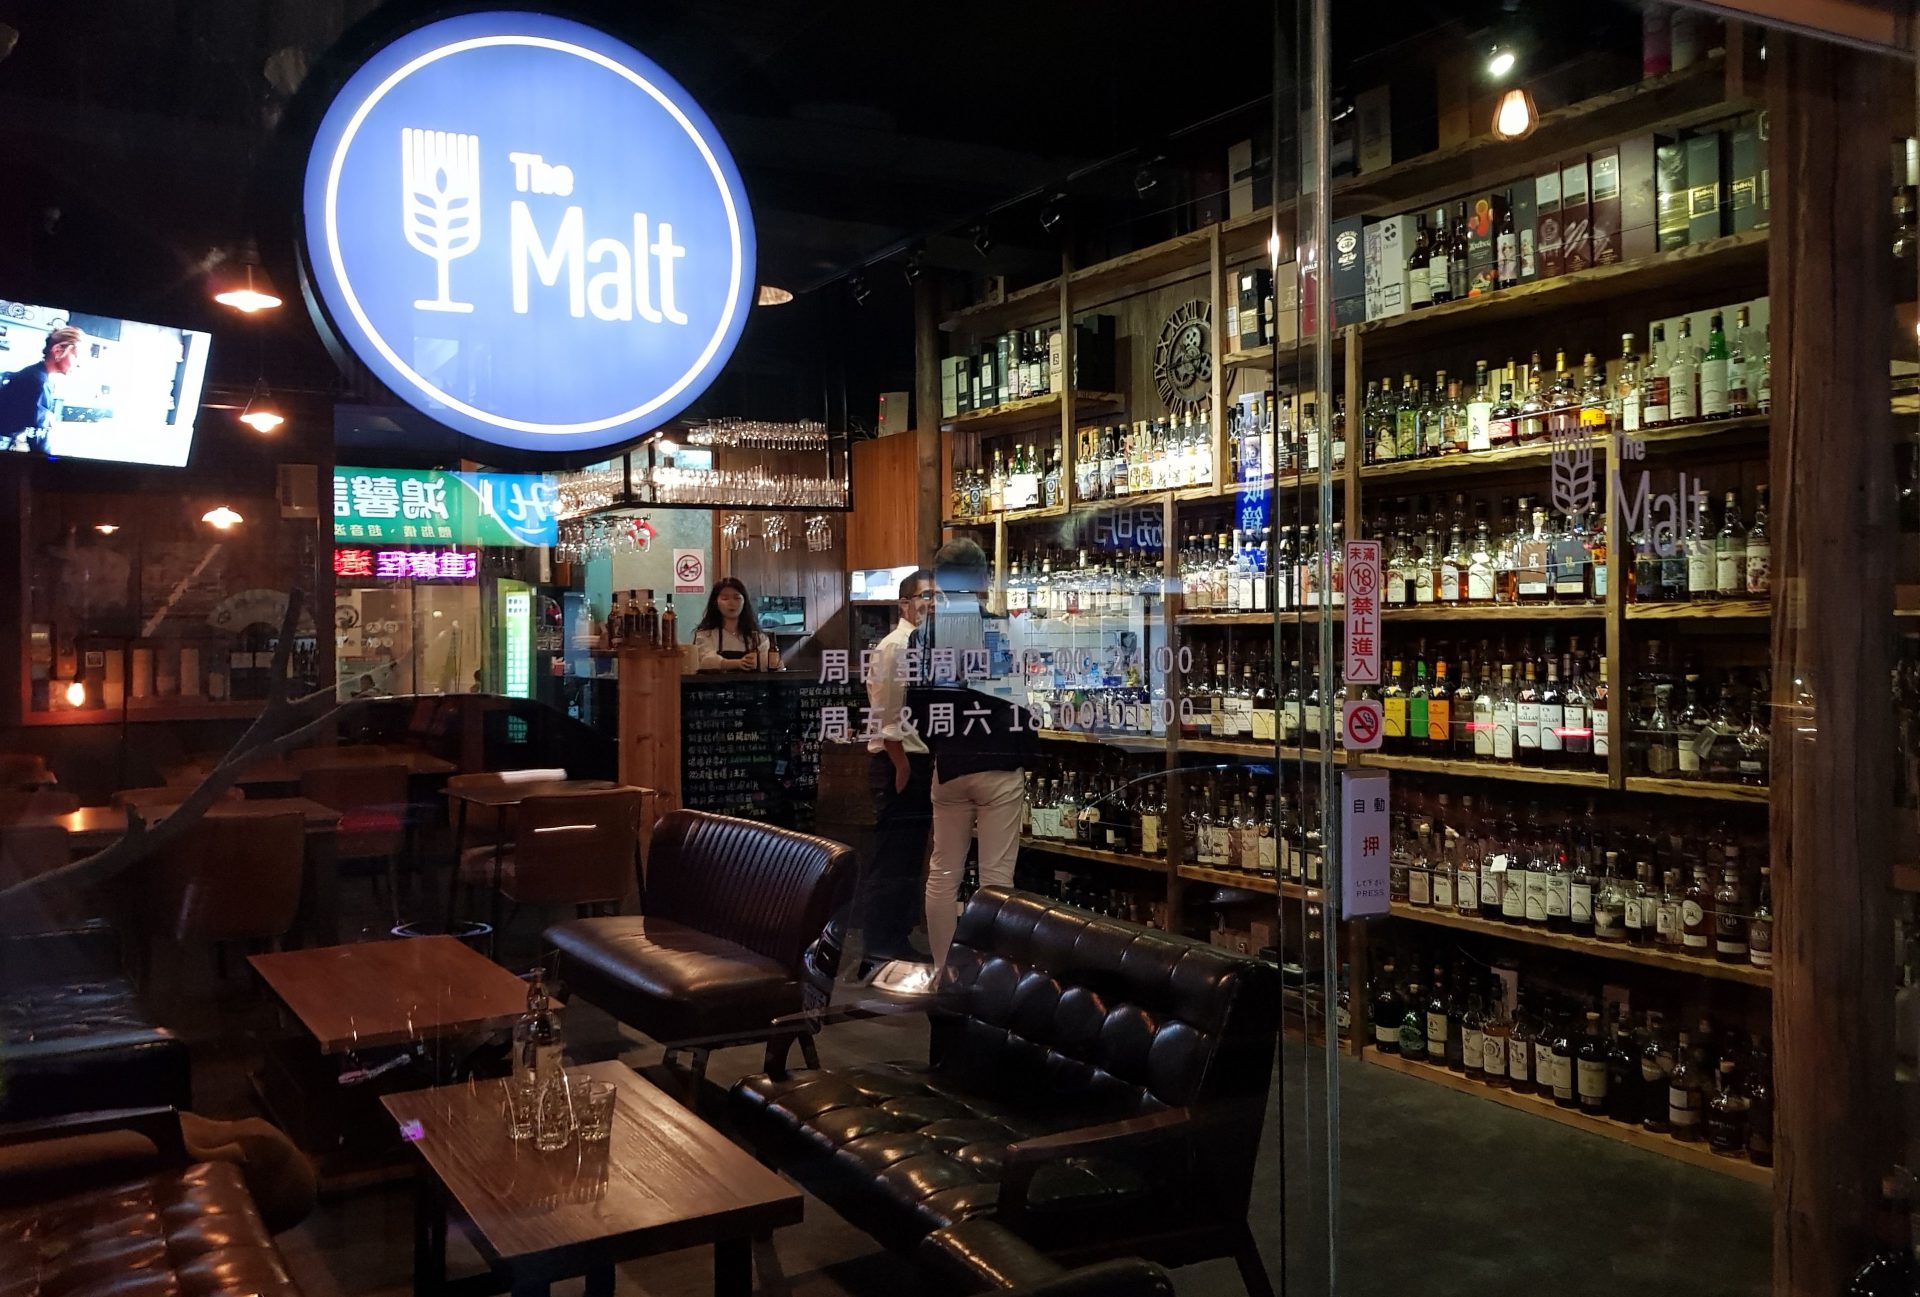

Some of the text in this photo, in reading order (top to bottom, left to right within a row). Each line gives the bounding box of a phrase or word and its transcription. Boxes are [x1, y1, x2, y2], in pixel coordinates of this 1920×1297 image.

[509, 151, 574, 197] The
[509, 201, 689, 325] Malt
[1615, 430, 1646, 461] The
[1612, 469, 1708, 557] Malt
[1350, 547, 1375, 561] 未滿
[1353, 568, 1372, 586] 18
[1351, 596, 1374, 677] 禁止進入
[818, 648, 991, 685] 周日至周四
[1354, 797, 1385, 813] 自動
[1363, 836, 1379, 857] 押
[1356, 889, 1385, 897] PRESS
